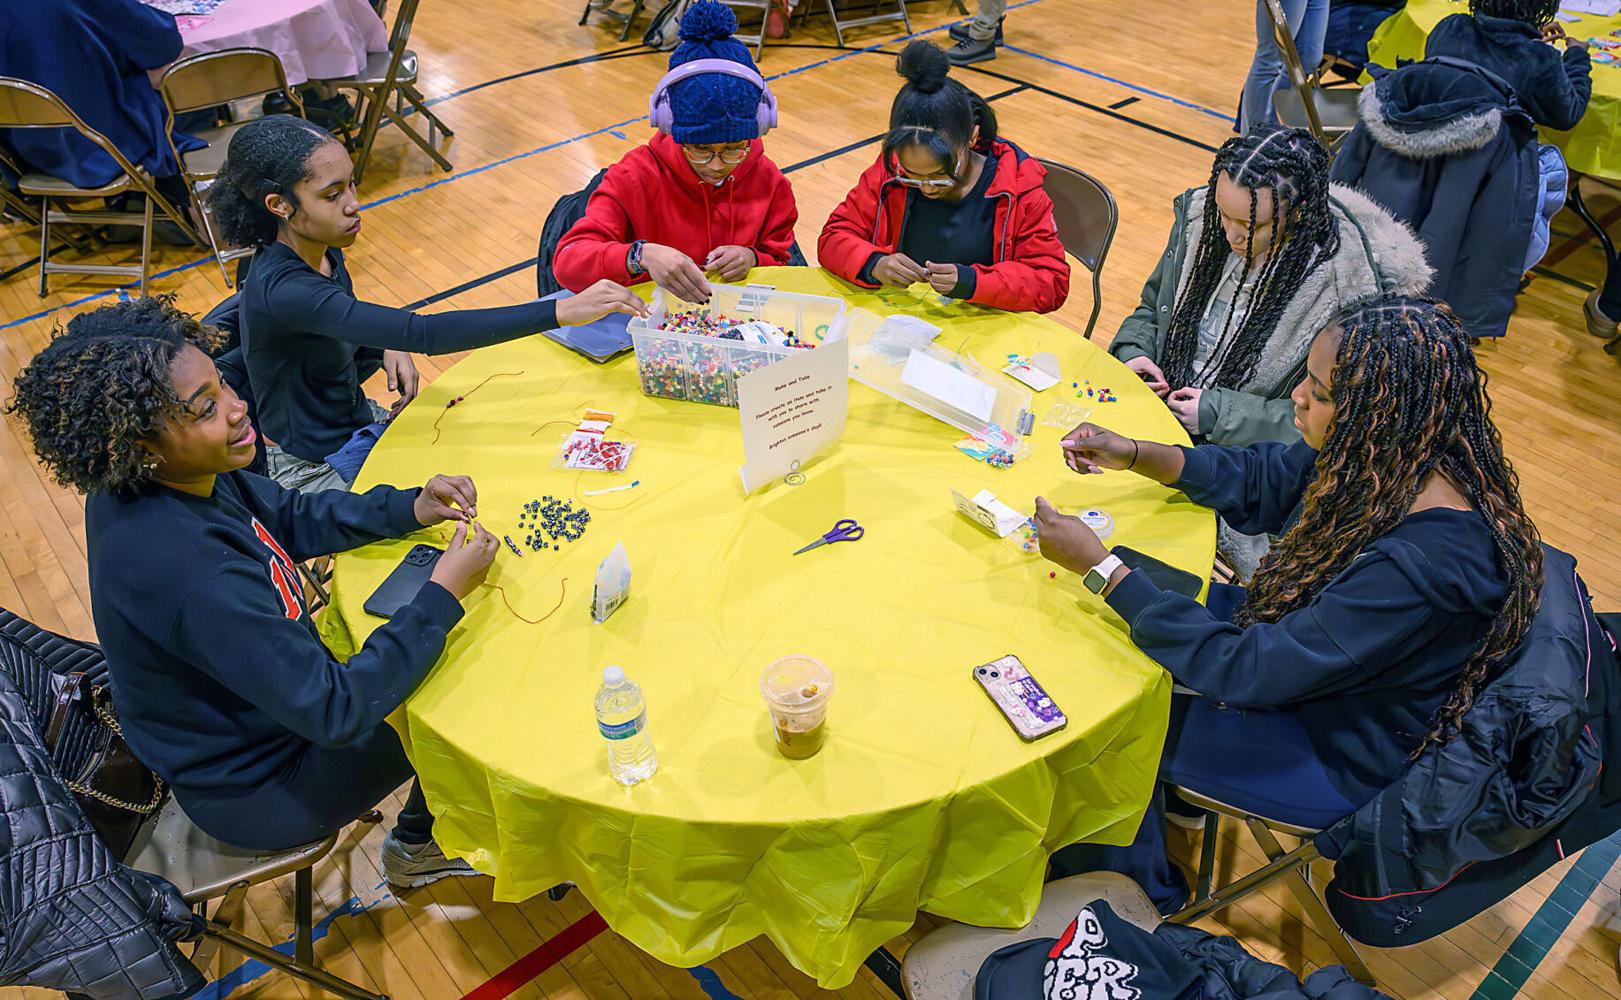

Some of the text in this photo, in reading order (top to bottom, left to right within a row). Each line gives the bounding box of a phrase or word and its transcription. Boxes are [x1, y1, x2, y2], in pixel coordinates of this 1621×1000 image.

[756, 411, 769, 420] Please
[771, 404, 785, 413] create
[773, 418, 791, 428] someone
[769, 438, 786, 449] Brighten
